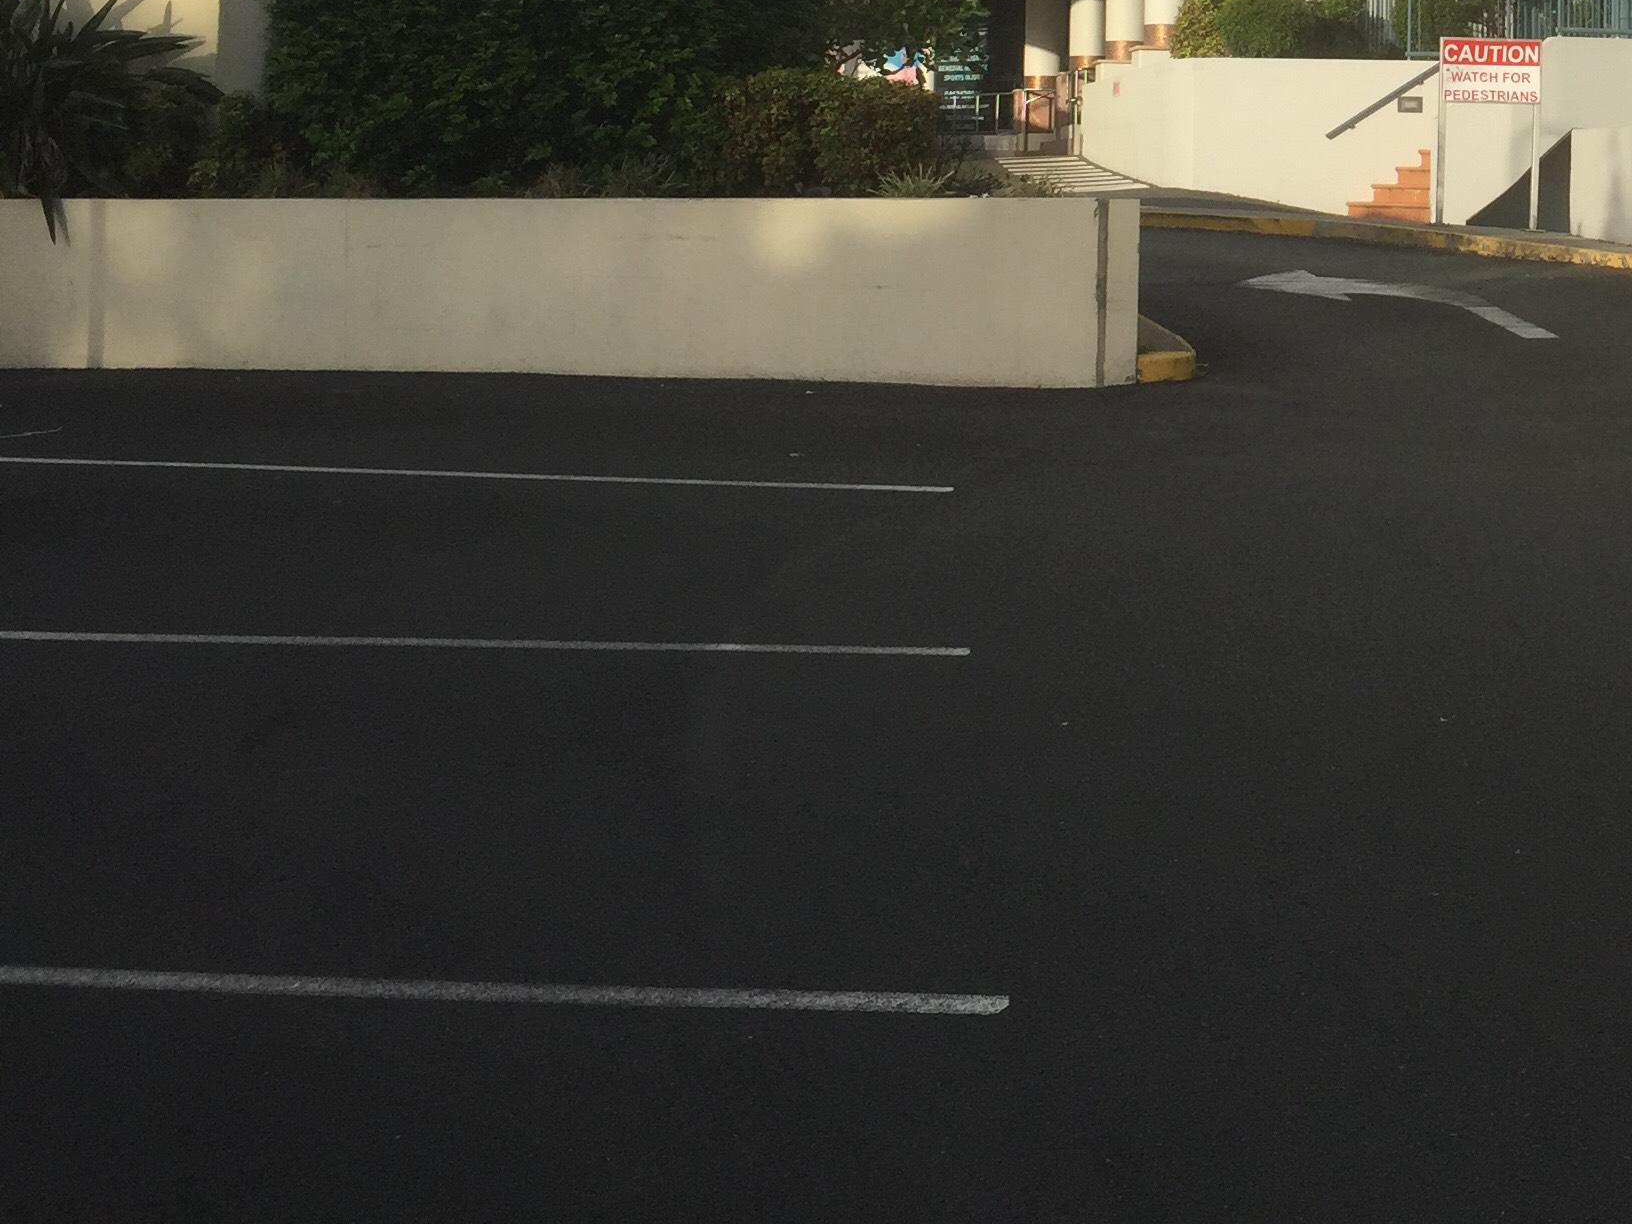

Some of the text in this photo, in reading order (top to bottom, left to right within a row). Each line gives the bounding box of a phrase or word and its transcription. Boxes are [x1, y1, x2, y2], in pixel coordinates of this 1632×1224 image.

[1444, 44, 1539, 63] CAUTION
[1451, 71, 1531, 83] WATCH FOR
[1444, 89, 1538, 102] PEDESTRIANS
